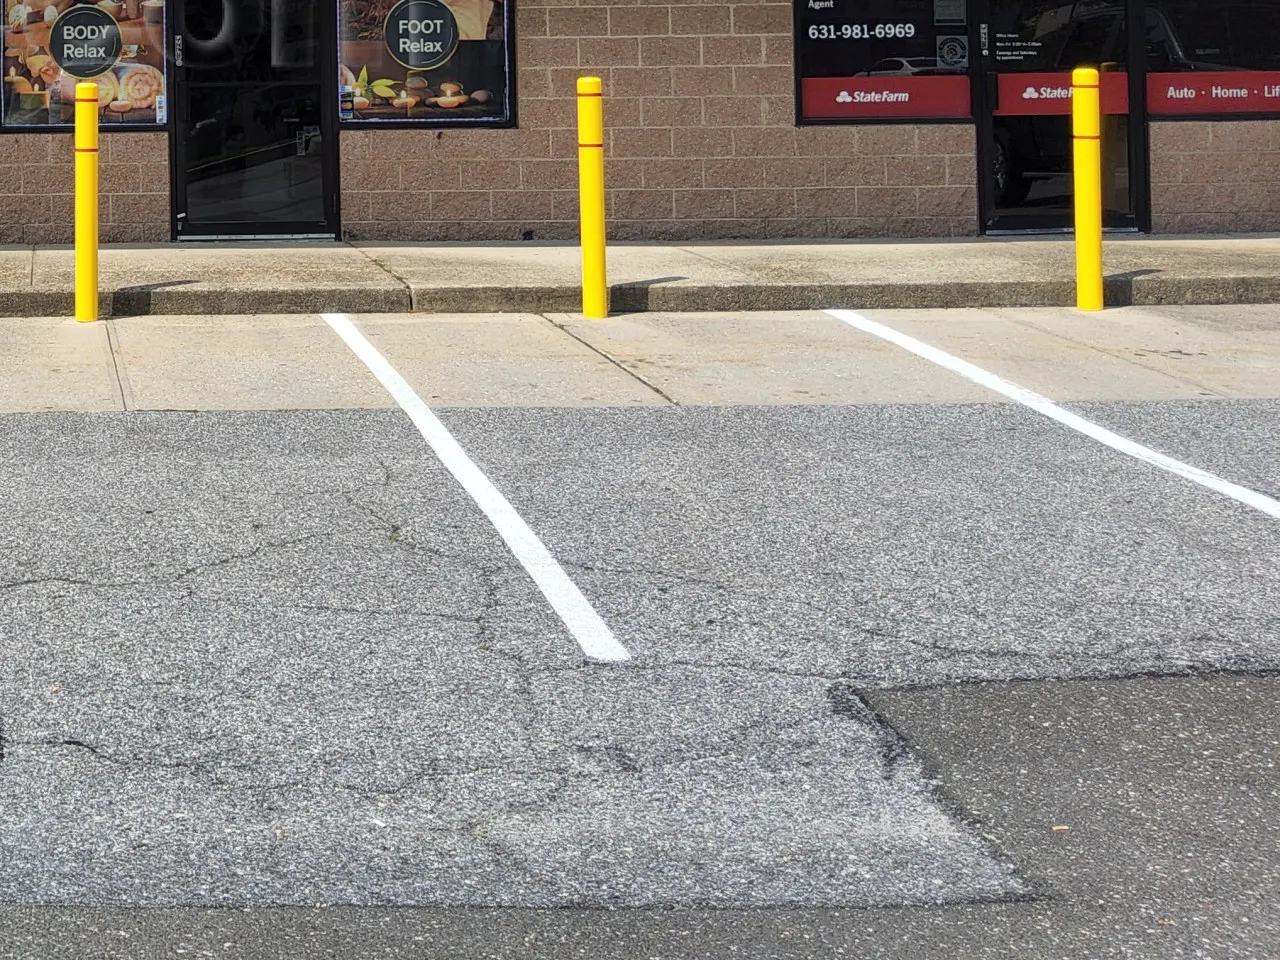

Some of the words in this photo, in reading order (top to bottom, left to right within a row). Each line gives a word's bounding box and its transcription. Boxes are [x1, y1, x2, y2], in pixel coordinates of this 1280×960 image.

[807, 0, 834, 10] Agent
[63, 25, 110, 40] BODY
[398, 19, 444, 35] FOOT
[808, 23, 915, 39] 631-981-6969
[63, 43, 107, 59] Relax
[399, 38, 443, 53] Relax
[852, 90, 910, 102] StateFarm
[1039, 86, 1075, 99] StateF
[1166, 86, 1196, 99] Auto
[1211, 85, 1249, 98] Home
